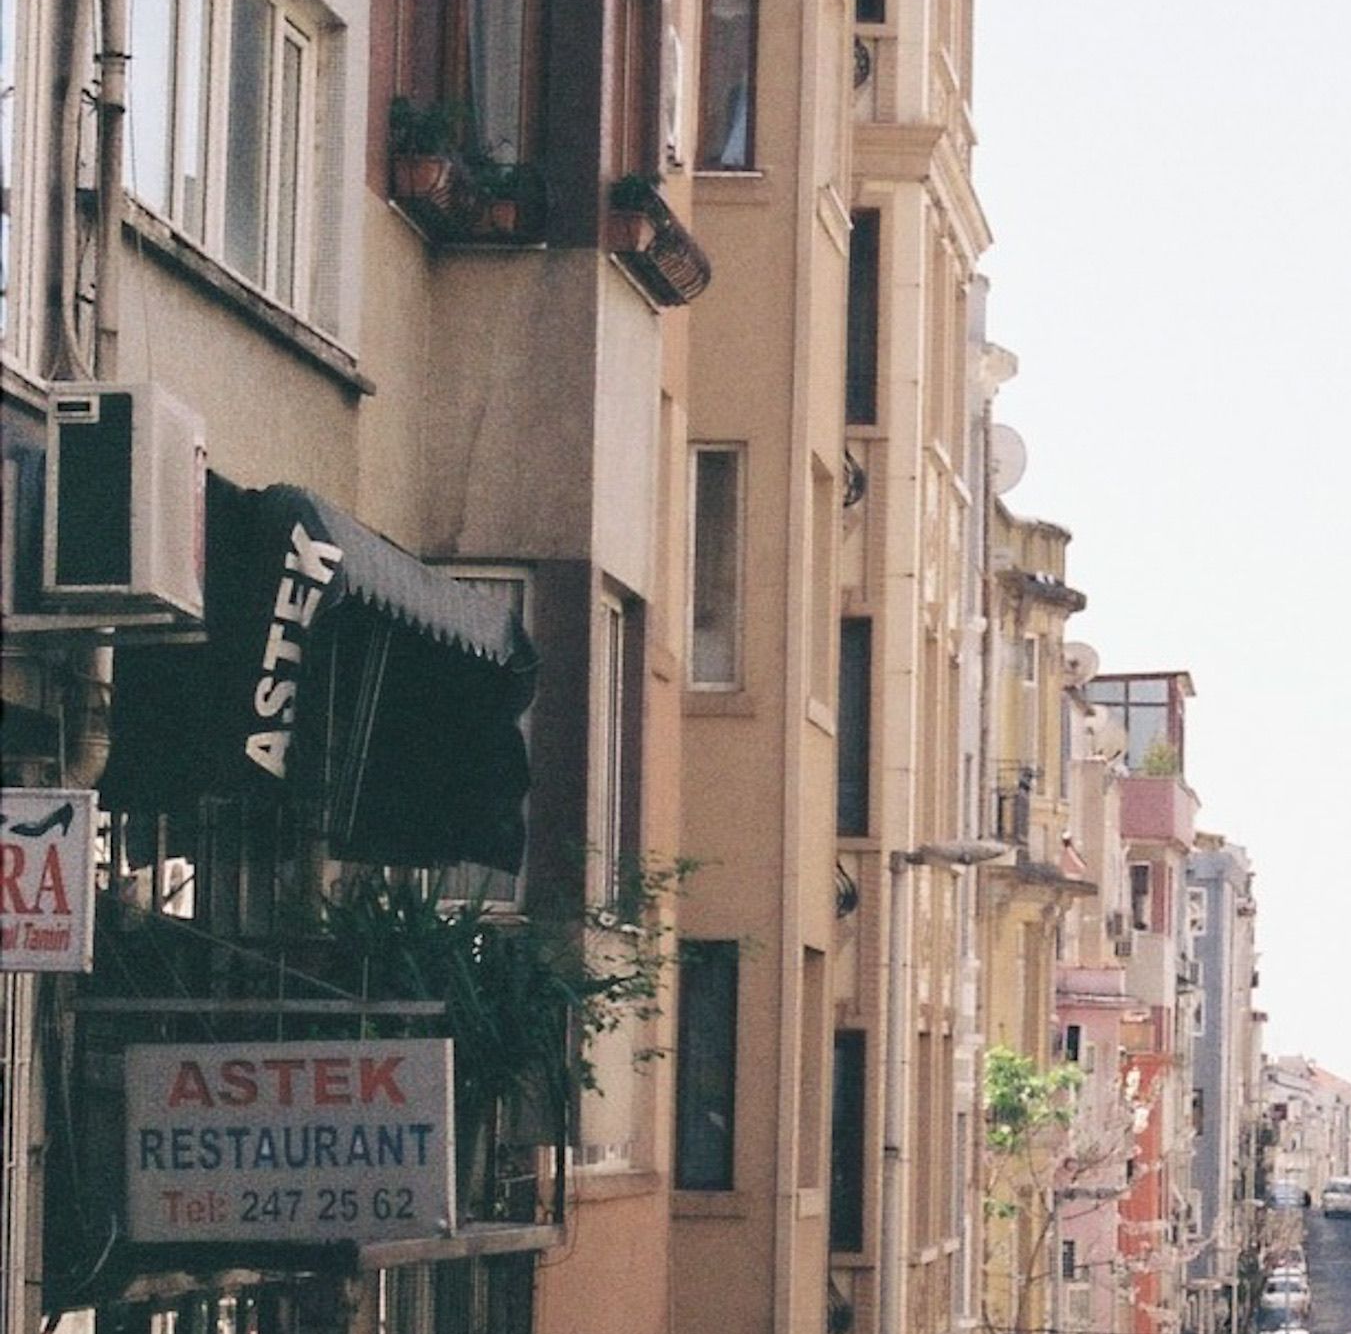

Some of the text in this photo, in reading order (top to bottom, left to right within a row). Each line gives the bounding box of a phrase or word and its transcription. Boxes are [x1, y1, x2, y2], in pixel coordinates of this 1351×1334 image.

[246, 521, 344, 779] ASTEK
[168, 1056, 406, 1108] ASTEK
[139, 1123, 434, 1171] RESTAURANT
[240, 1189, 302, 1222] 247
[318, 1188, 359, 1220] 25
[372, 1187, 415, 1220] 62
